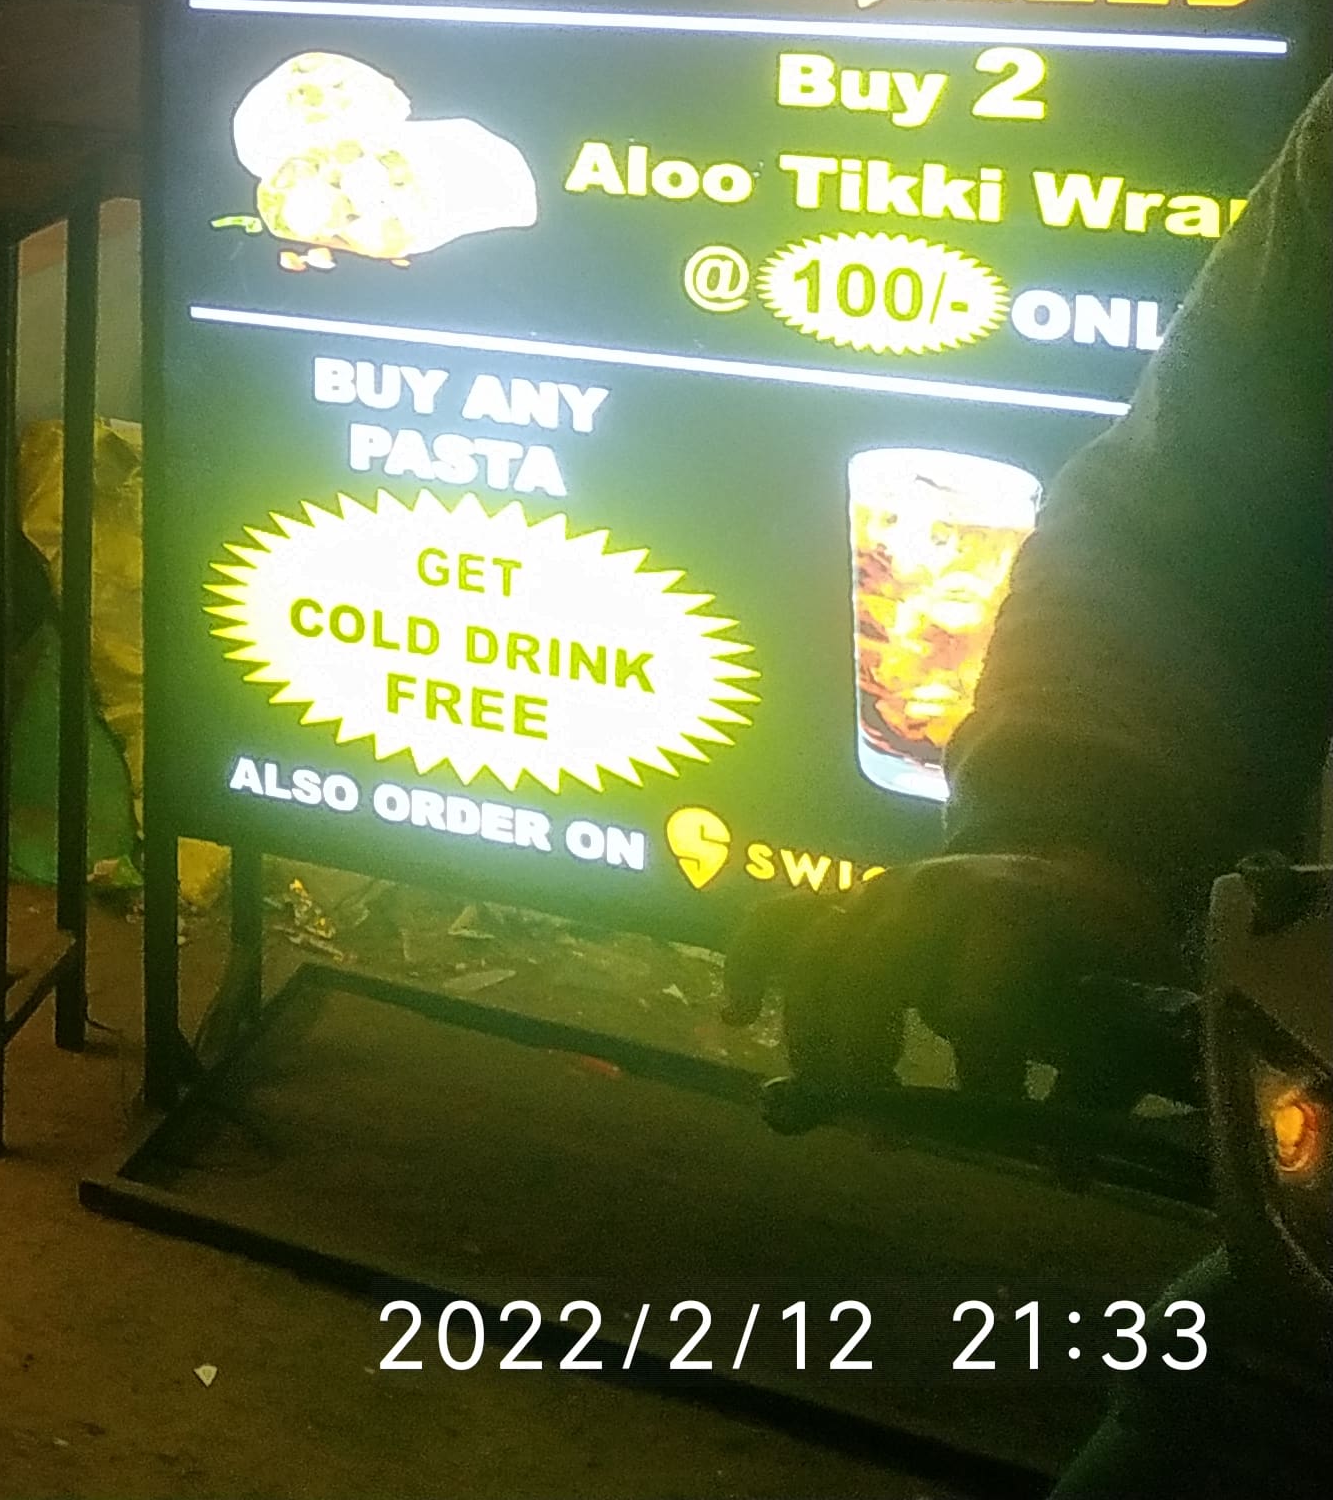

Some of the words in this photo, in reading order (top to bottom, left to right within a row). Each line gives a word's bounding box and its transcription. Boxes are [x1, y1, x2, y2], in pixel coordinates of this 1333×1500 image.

[777, 53, 949, 128] Buy
[971, 46, 1048, 122] 2
[564, 143, 754, 205] Aloo
[777, 153, 1005, 223] Tikki
[683, 245, 753, 314] @
[792, 261, 975, 326] 100/-
[1011, 289, 1184, 351] ONL
[314, 356, 449, 416] BUY
[463, 373, 609, 434] ANY
[347, 423, 568, 497] PASTA
[416, 547, 523, 598] GET
[289, 596, 442, 658] COLD
[464, 625, 656, 694] DRINK
[385, 674, 549, 741] FREE
[229, 756, 360, 814] ALSO
[372, 783, 551, 853] ORDER
[564, 819, 647, 871] ON
